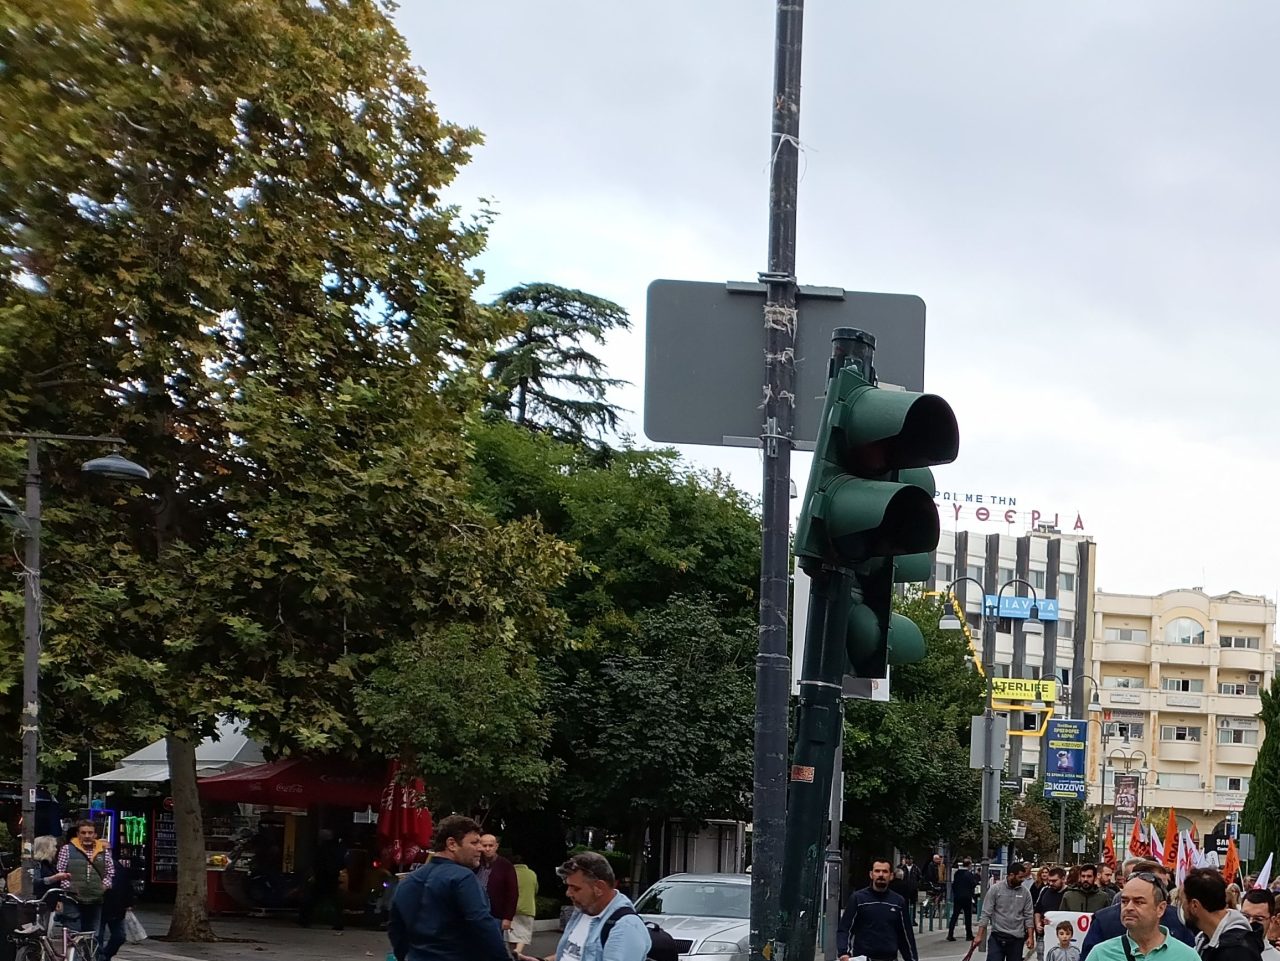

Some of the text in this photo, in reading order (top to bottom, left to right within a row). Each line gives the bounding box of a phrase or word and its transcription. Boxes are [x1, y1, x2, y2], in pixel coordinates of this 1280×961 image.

[934, 491, 1016, 506] ΡΩΙ ΜΕ ΤΗΝ
[934, 503, 1084, 530] ΥΘΕΡΙΑ
[986, 598, 1055, 612] AIAVTA
